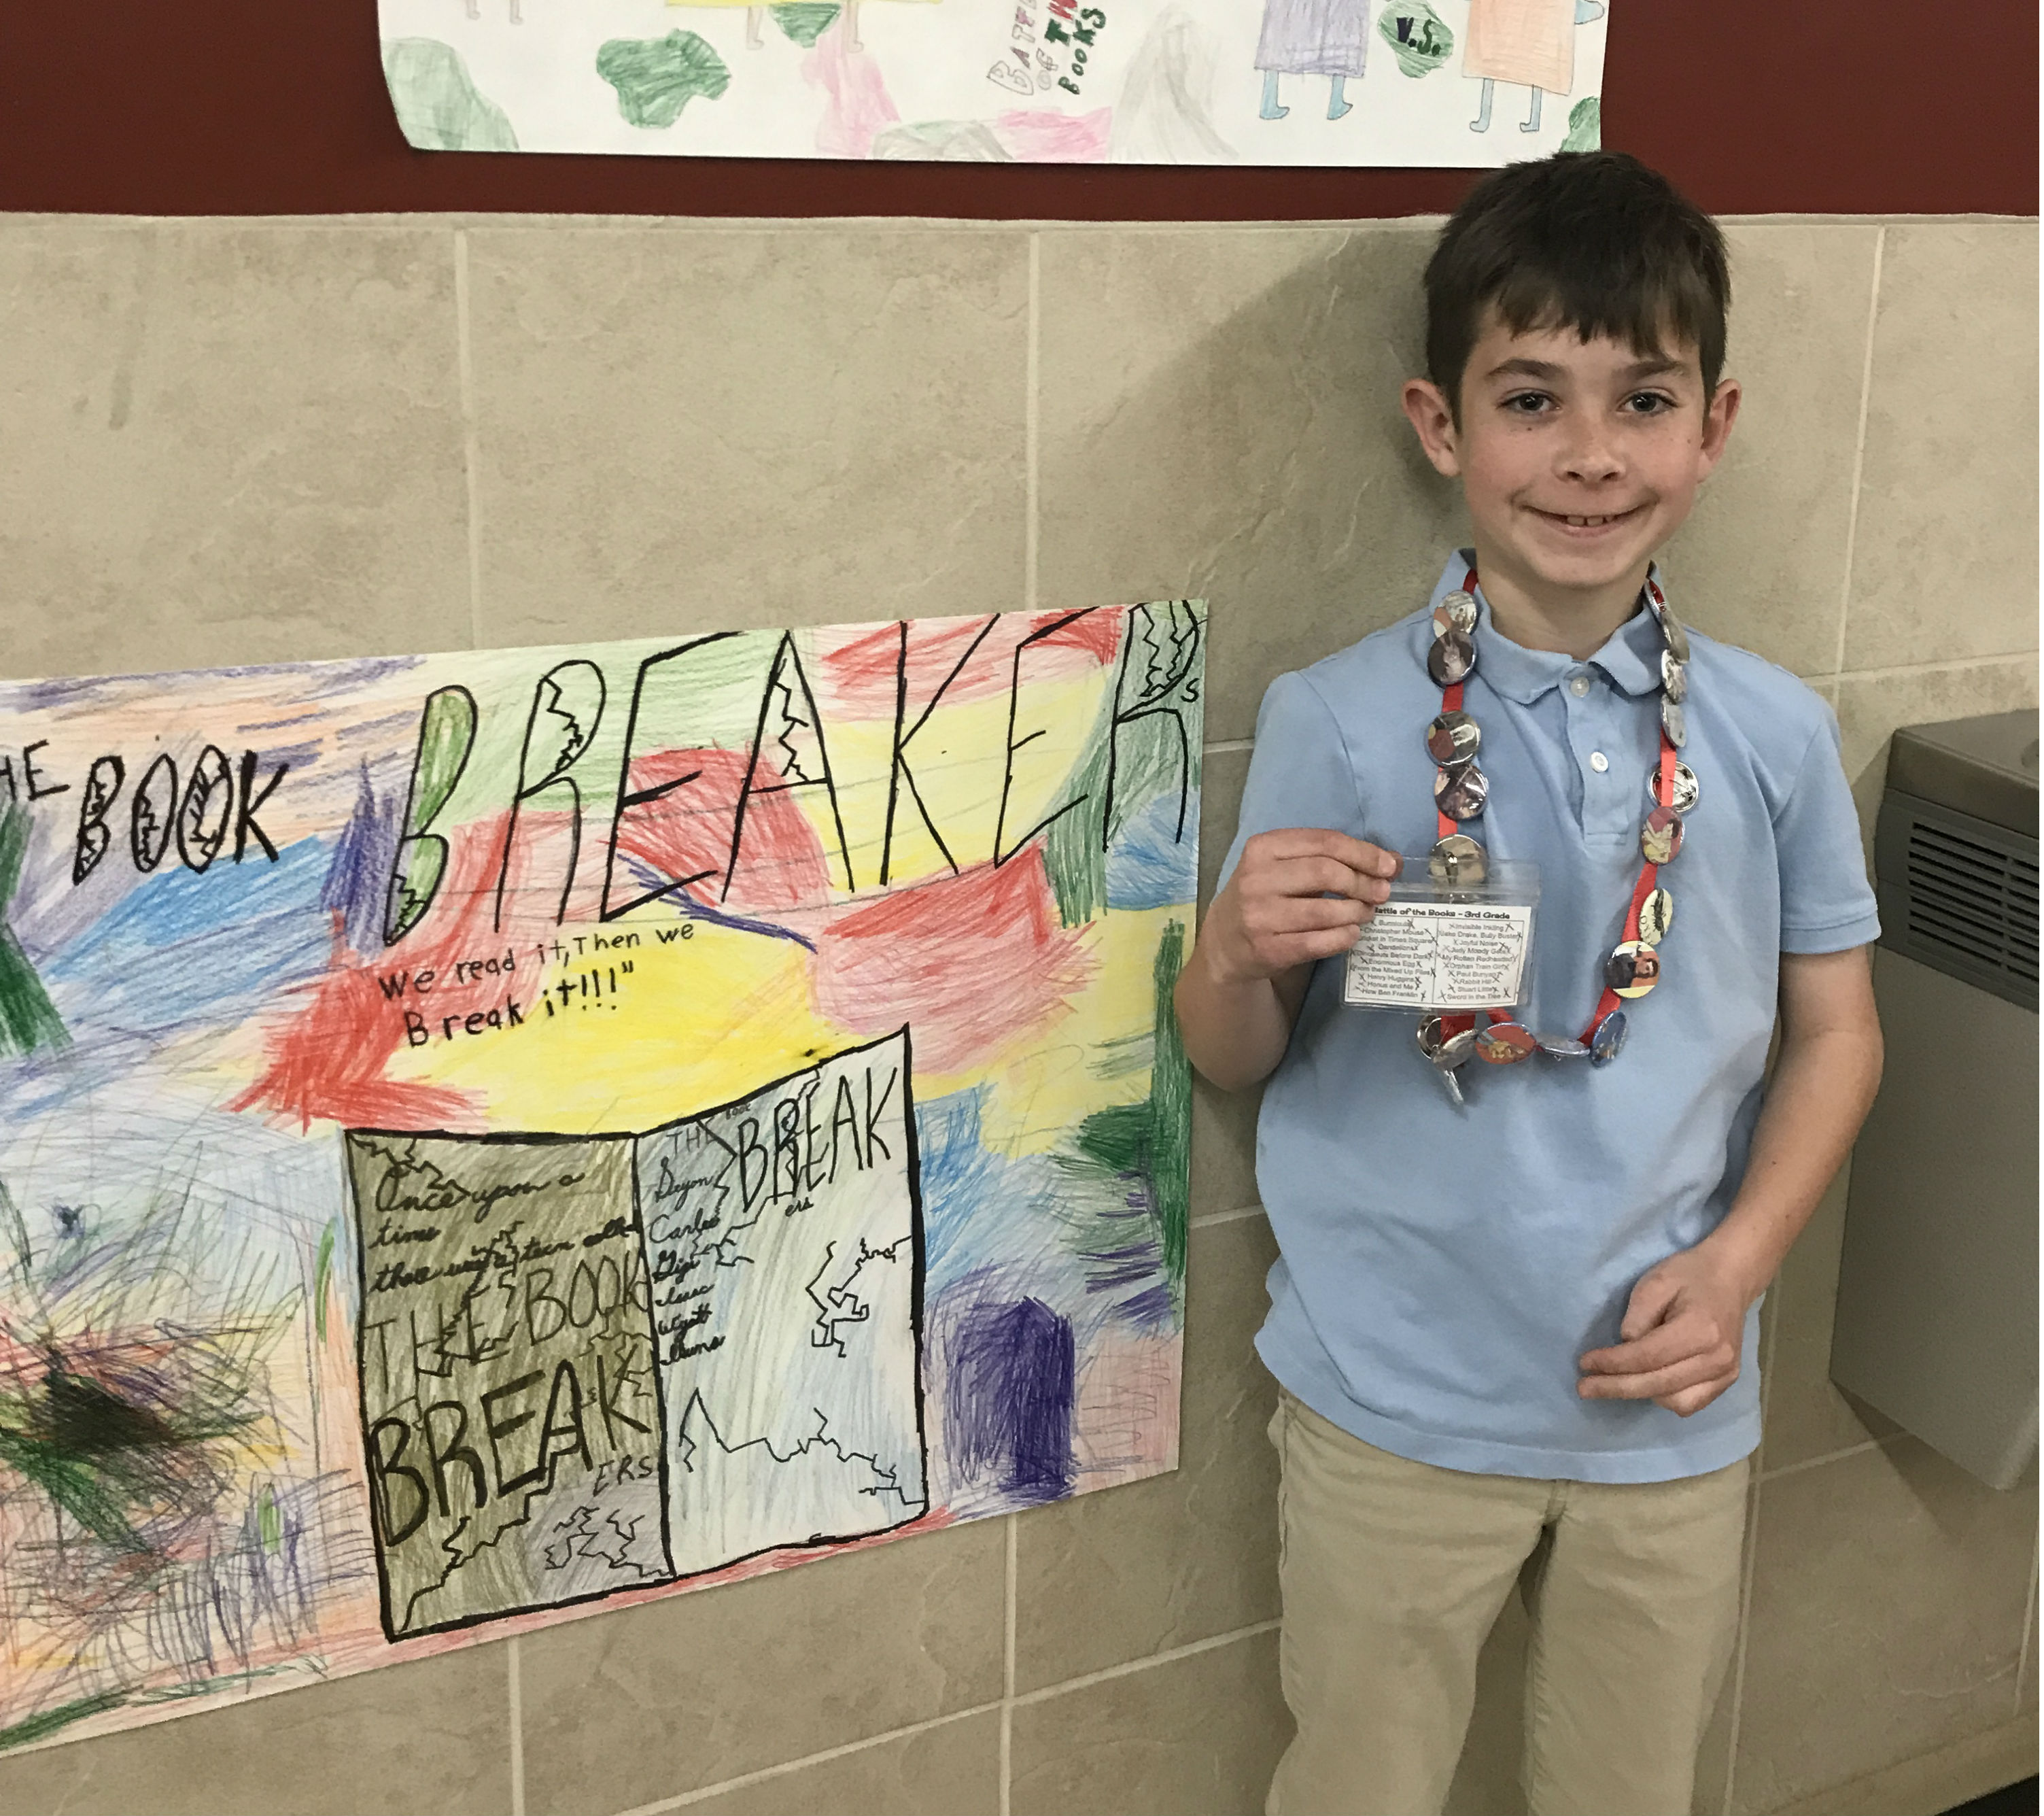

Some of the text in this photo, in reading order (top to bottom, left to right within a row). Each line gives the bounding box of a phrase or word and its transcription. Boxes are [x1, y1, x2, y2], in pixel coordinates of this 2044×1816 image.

[986, 0, 1037, 95] BATT
[1058, 8, 1107, 95] BOOKS
[72, 744, 290, 885] BOOK
[378, 970, 435, 1000] We
[456, 948, 517, 984] read
[655, 923, 695, 944] we
[403, 994, 524, 1048] Break
[738, 1067, 898, 1212] BREAK
[375, 1162, 585, 1223] Once upon a
[525, 1252, 651, 1346] BOOK
[369, 1343, 651, 1547] BREAK
[593, 1456, 653, 1497] ERS
